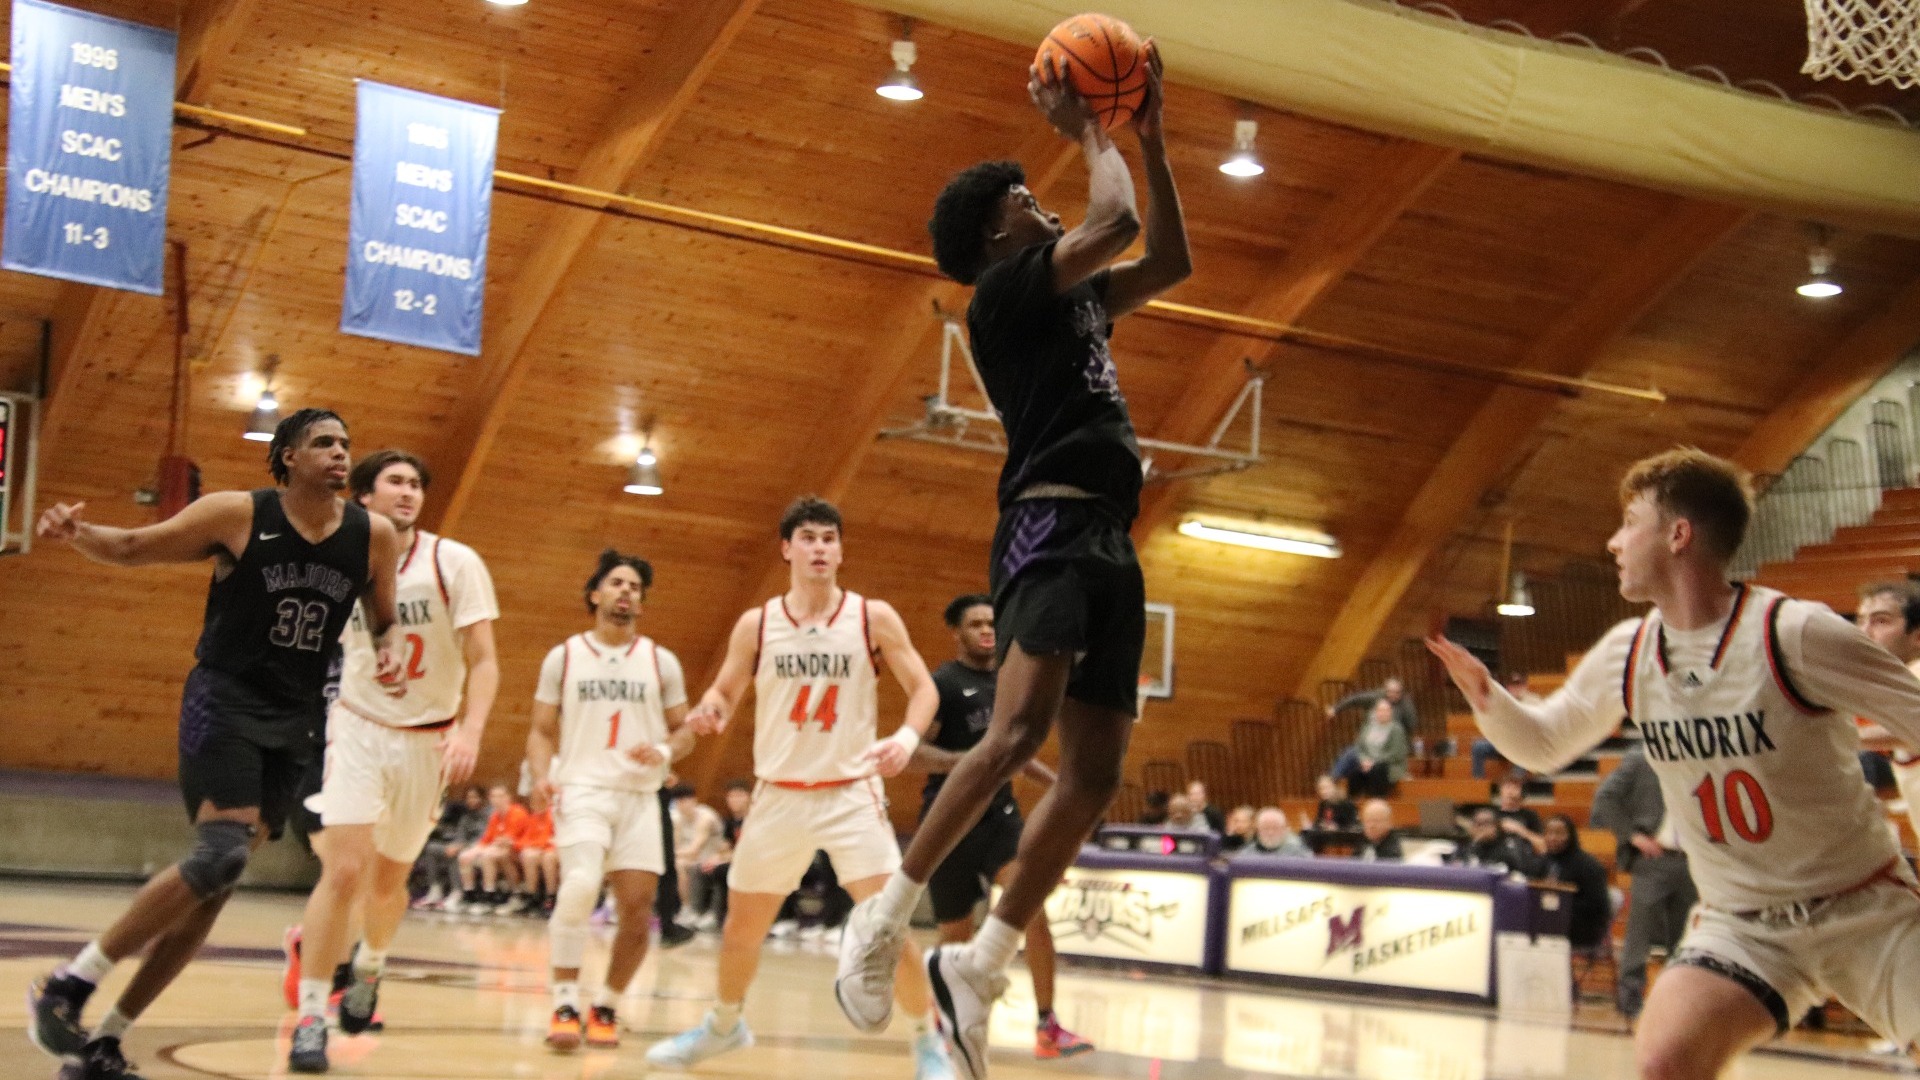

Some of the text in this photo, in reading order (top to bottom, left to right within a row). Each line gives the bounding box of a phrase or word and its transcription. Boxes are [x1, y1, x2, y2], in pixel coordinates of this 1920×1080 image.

[71, 42, 118, 71] 1996
[60, 84, 126, 117] MEN'S
[61, 129, 122, 161] SCAC
[25, 168, 153, 212] CHAMPIONS
[396, 161, 453, 192] MEN'S
[63, 222, 109, 250] 11-3
[395, 203, 448, 233] SCAC
[364, 240, 472, 280] CHAMPIONS
[394, 289, 437, 315] 12-2
[261, 562, 353, 603] MAJORS
[269, 597, 330, 652] 32
[351, 599, 432, 633] HRIX
[775, 653, 852, 679] HENDRIX
[578, 680, 646, 703] HENDRIX
[790, 685, 839, 732] 44
[605, 710, 622, 750] 1
[1640, 710, 1776, 762] HENDRIX
[1692, 769, 1774, 845] 10
[1241, 897, 1335, 946] MILLSAPS
[1325, 905, 1366, 958] M
[1353, 912, 1478, 975] BASKETBALL
